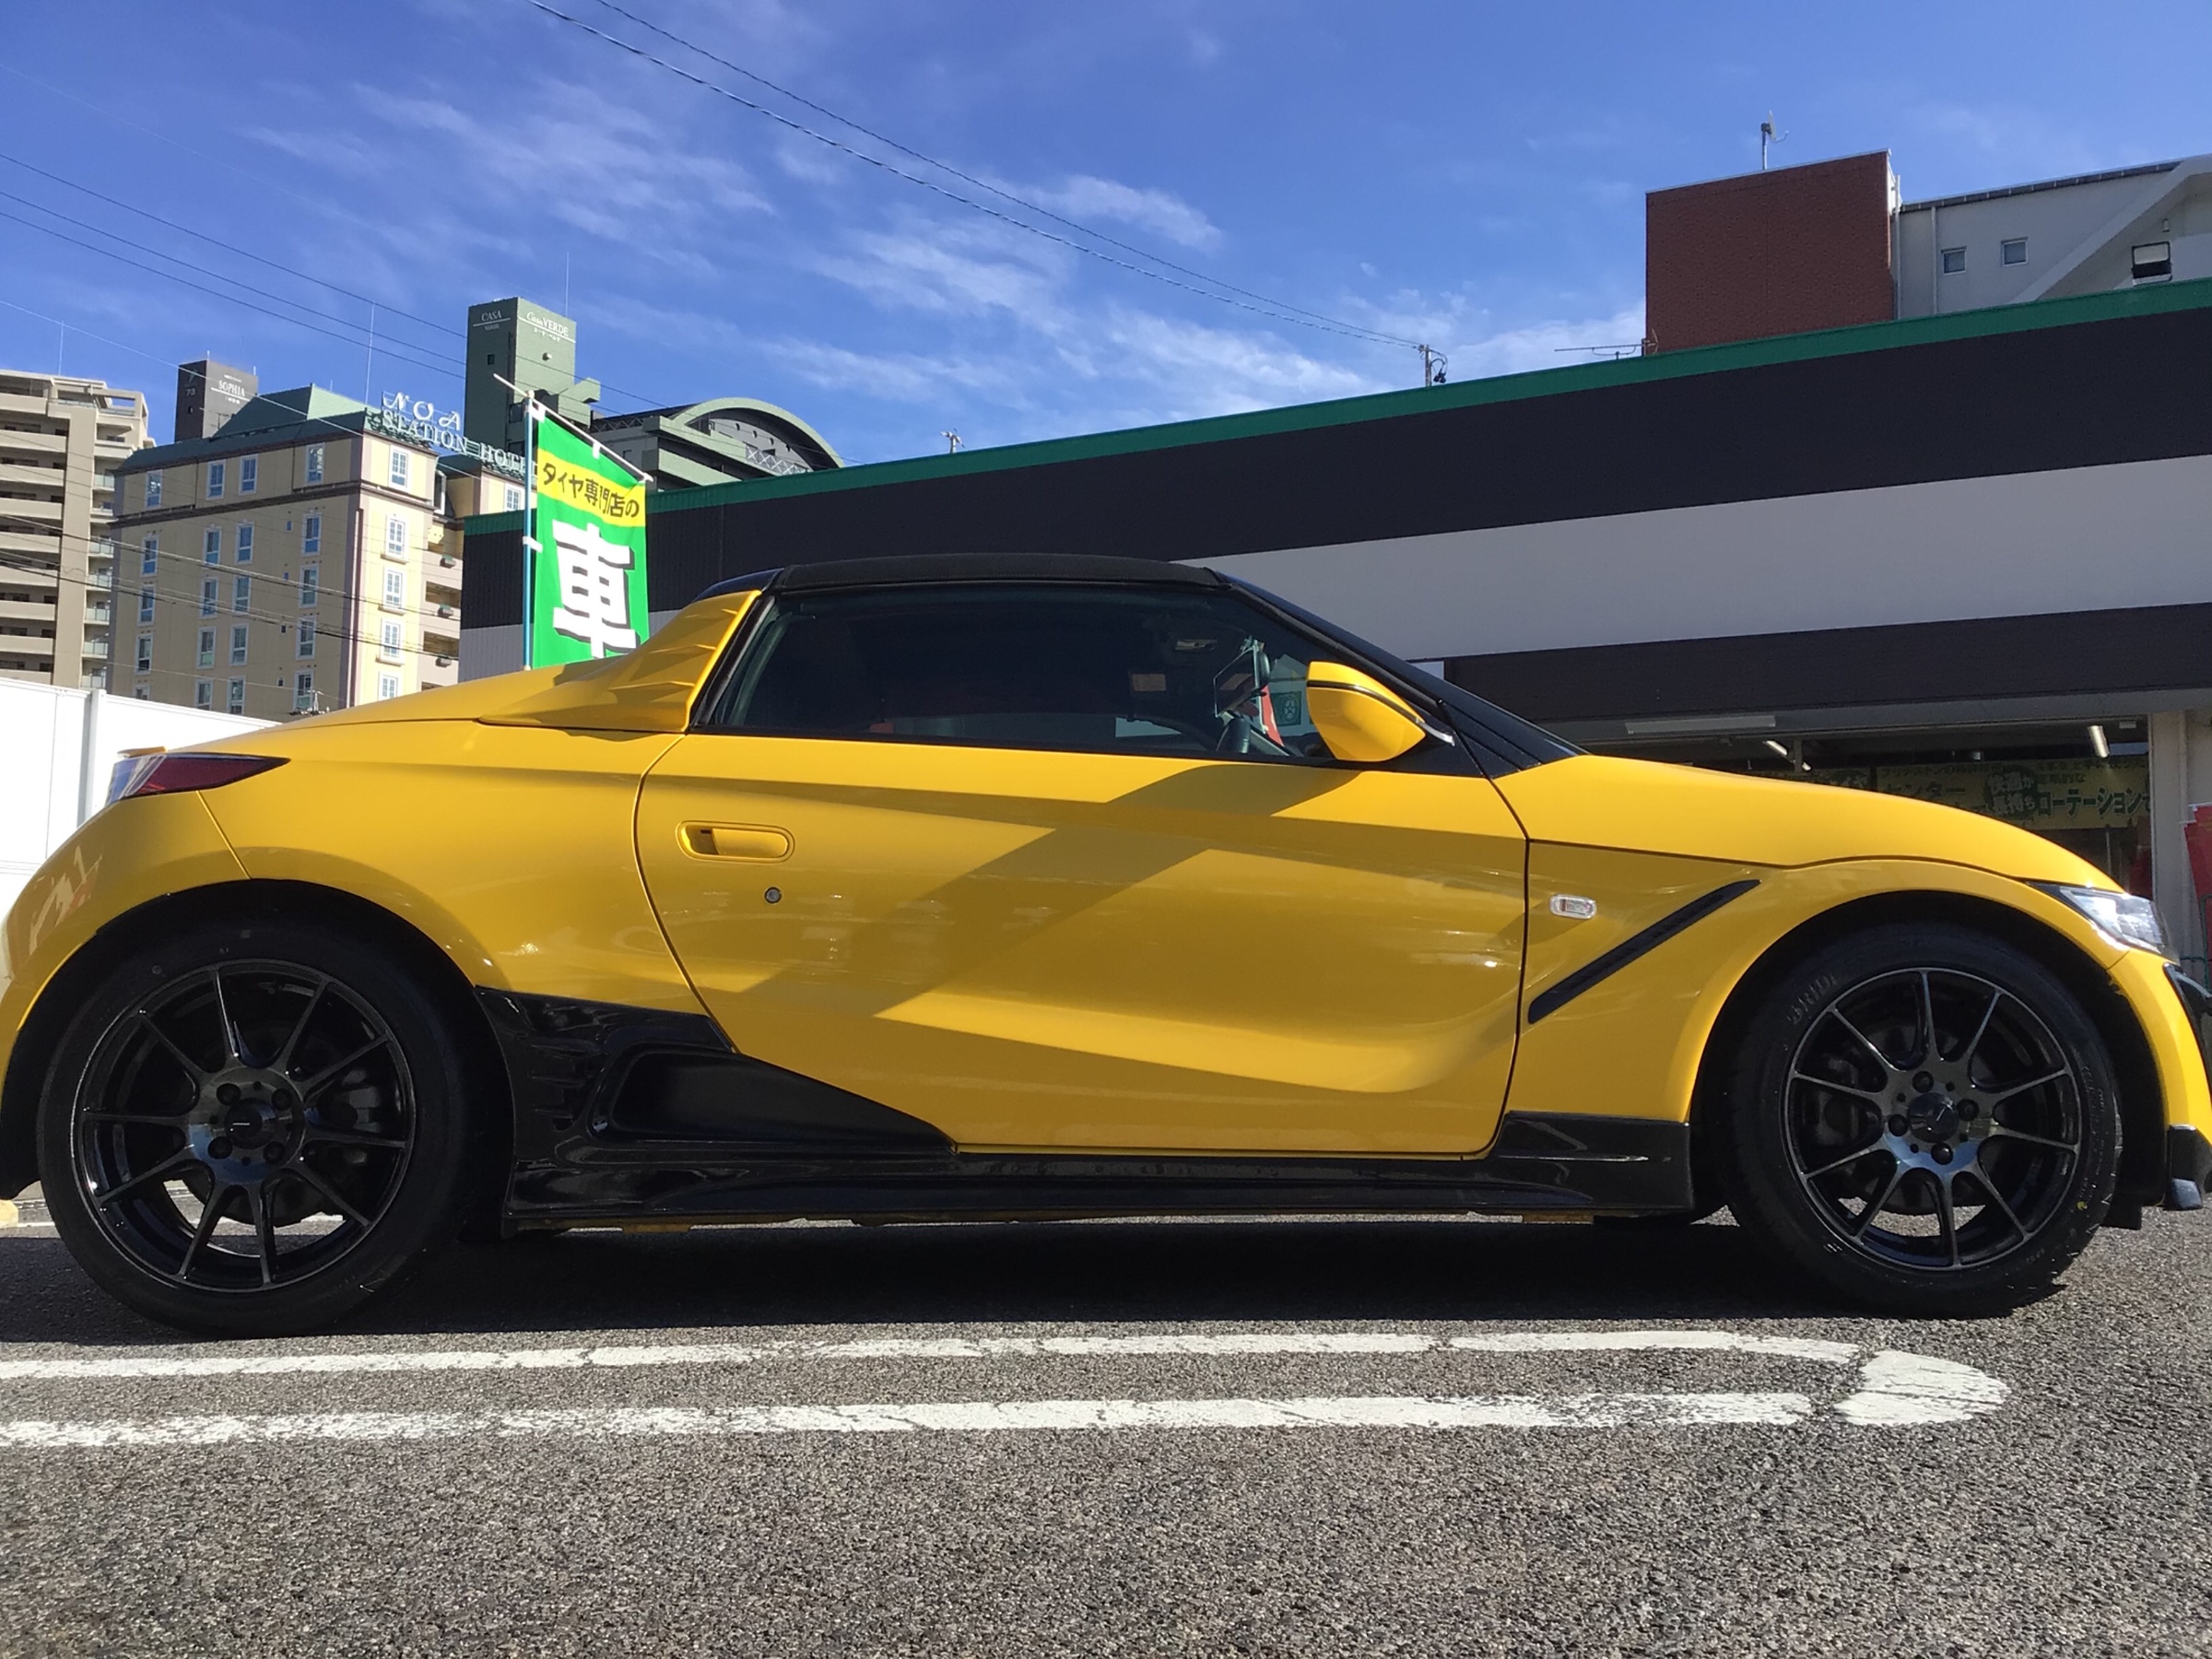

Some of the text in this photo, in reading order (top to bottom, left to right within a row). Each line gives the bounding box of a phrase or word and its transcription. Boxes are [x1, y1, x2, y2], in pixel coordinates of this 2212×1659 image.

[481, 311, 502, 322] CASA
[218, 380, 245, 397] SOPHIA
[382, 409, 468, 454] STATION
[542, 463, 641, 518] タイヤ専門店の
[552, 519, 640, 659] 車
